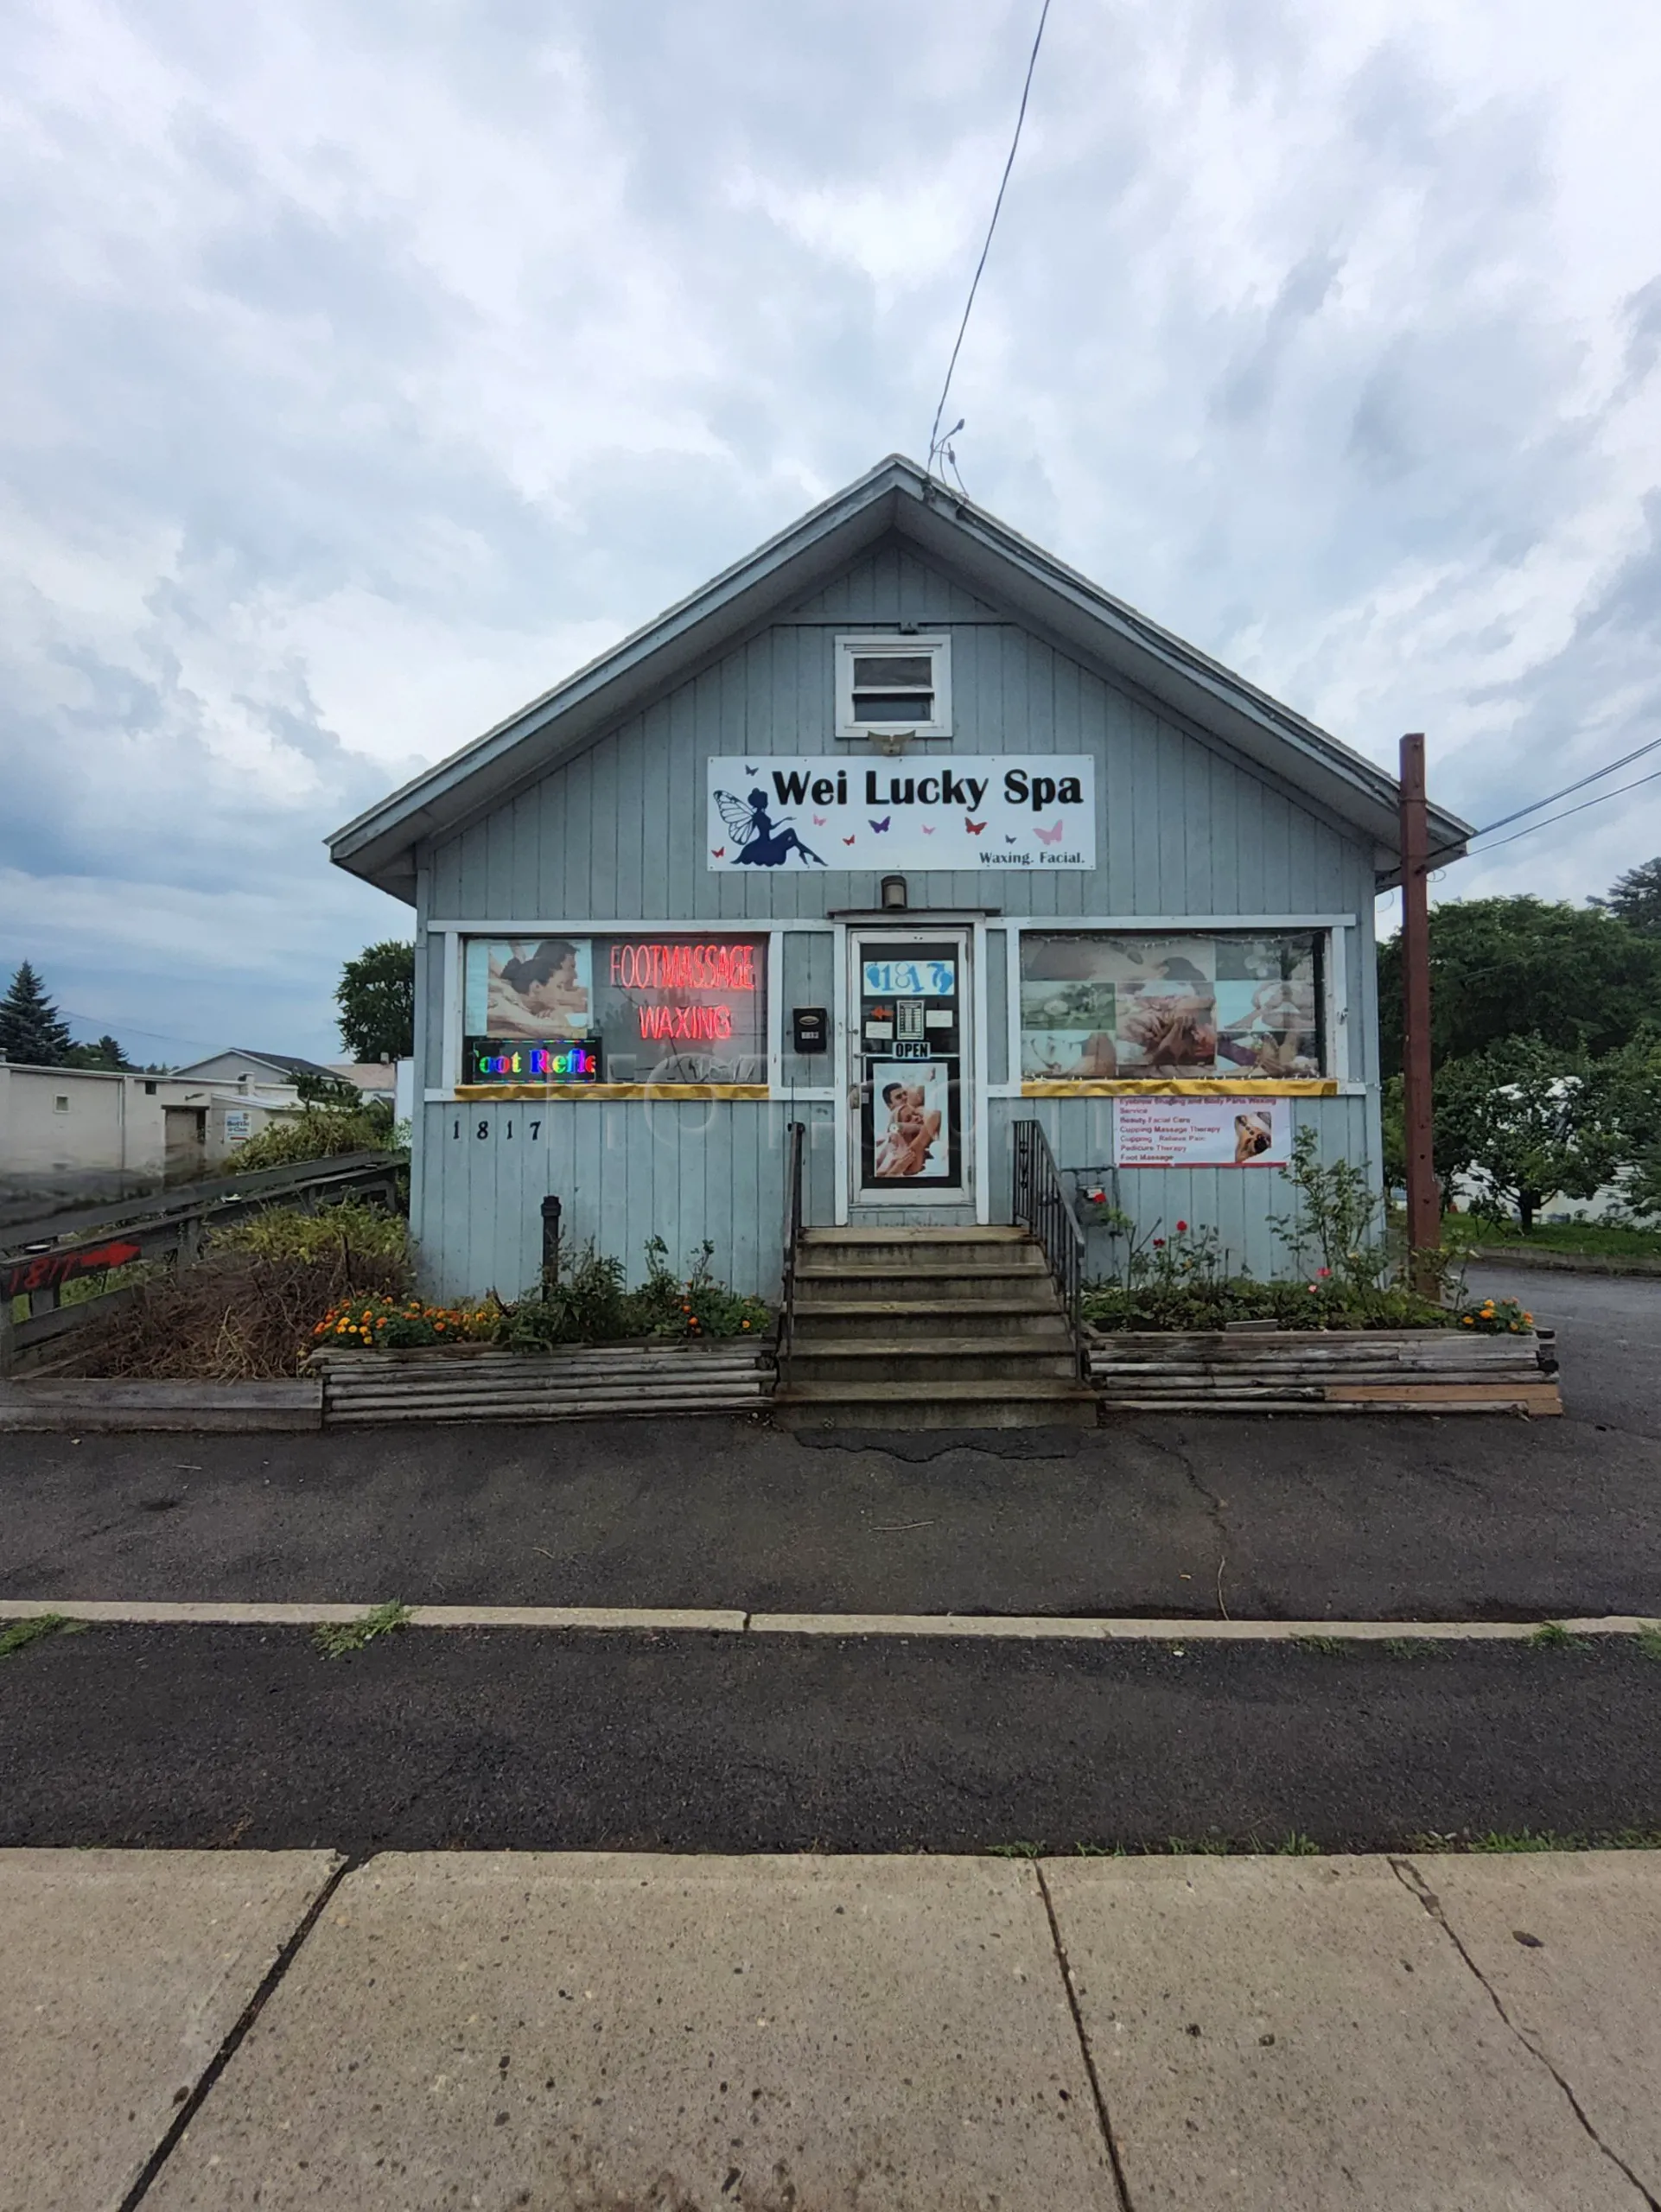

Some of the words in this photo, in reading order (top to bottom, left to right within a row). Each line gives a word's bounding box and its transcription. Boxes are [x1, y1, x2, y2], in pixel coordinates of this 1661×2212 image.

[772, 769, 848, 805] Wei
[866, 769, 989, 813] Lucky
[1004, 768, 1085, 812] Spa
[640, 1005, 732, 1039] WAXING
[474, 1048, 523, 1073] oot
[895, 1043, 929, 1058] OPEN
[453, 1120, 542, 1141] 1817
